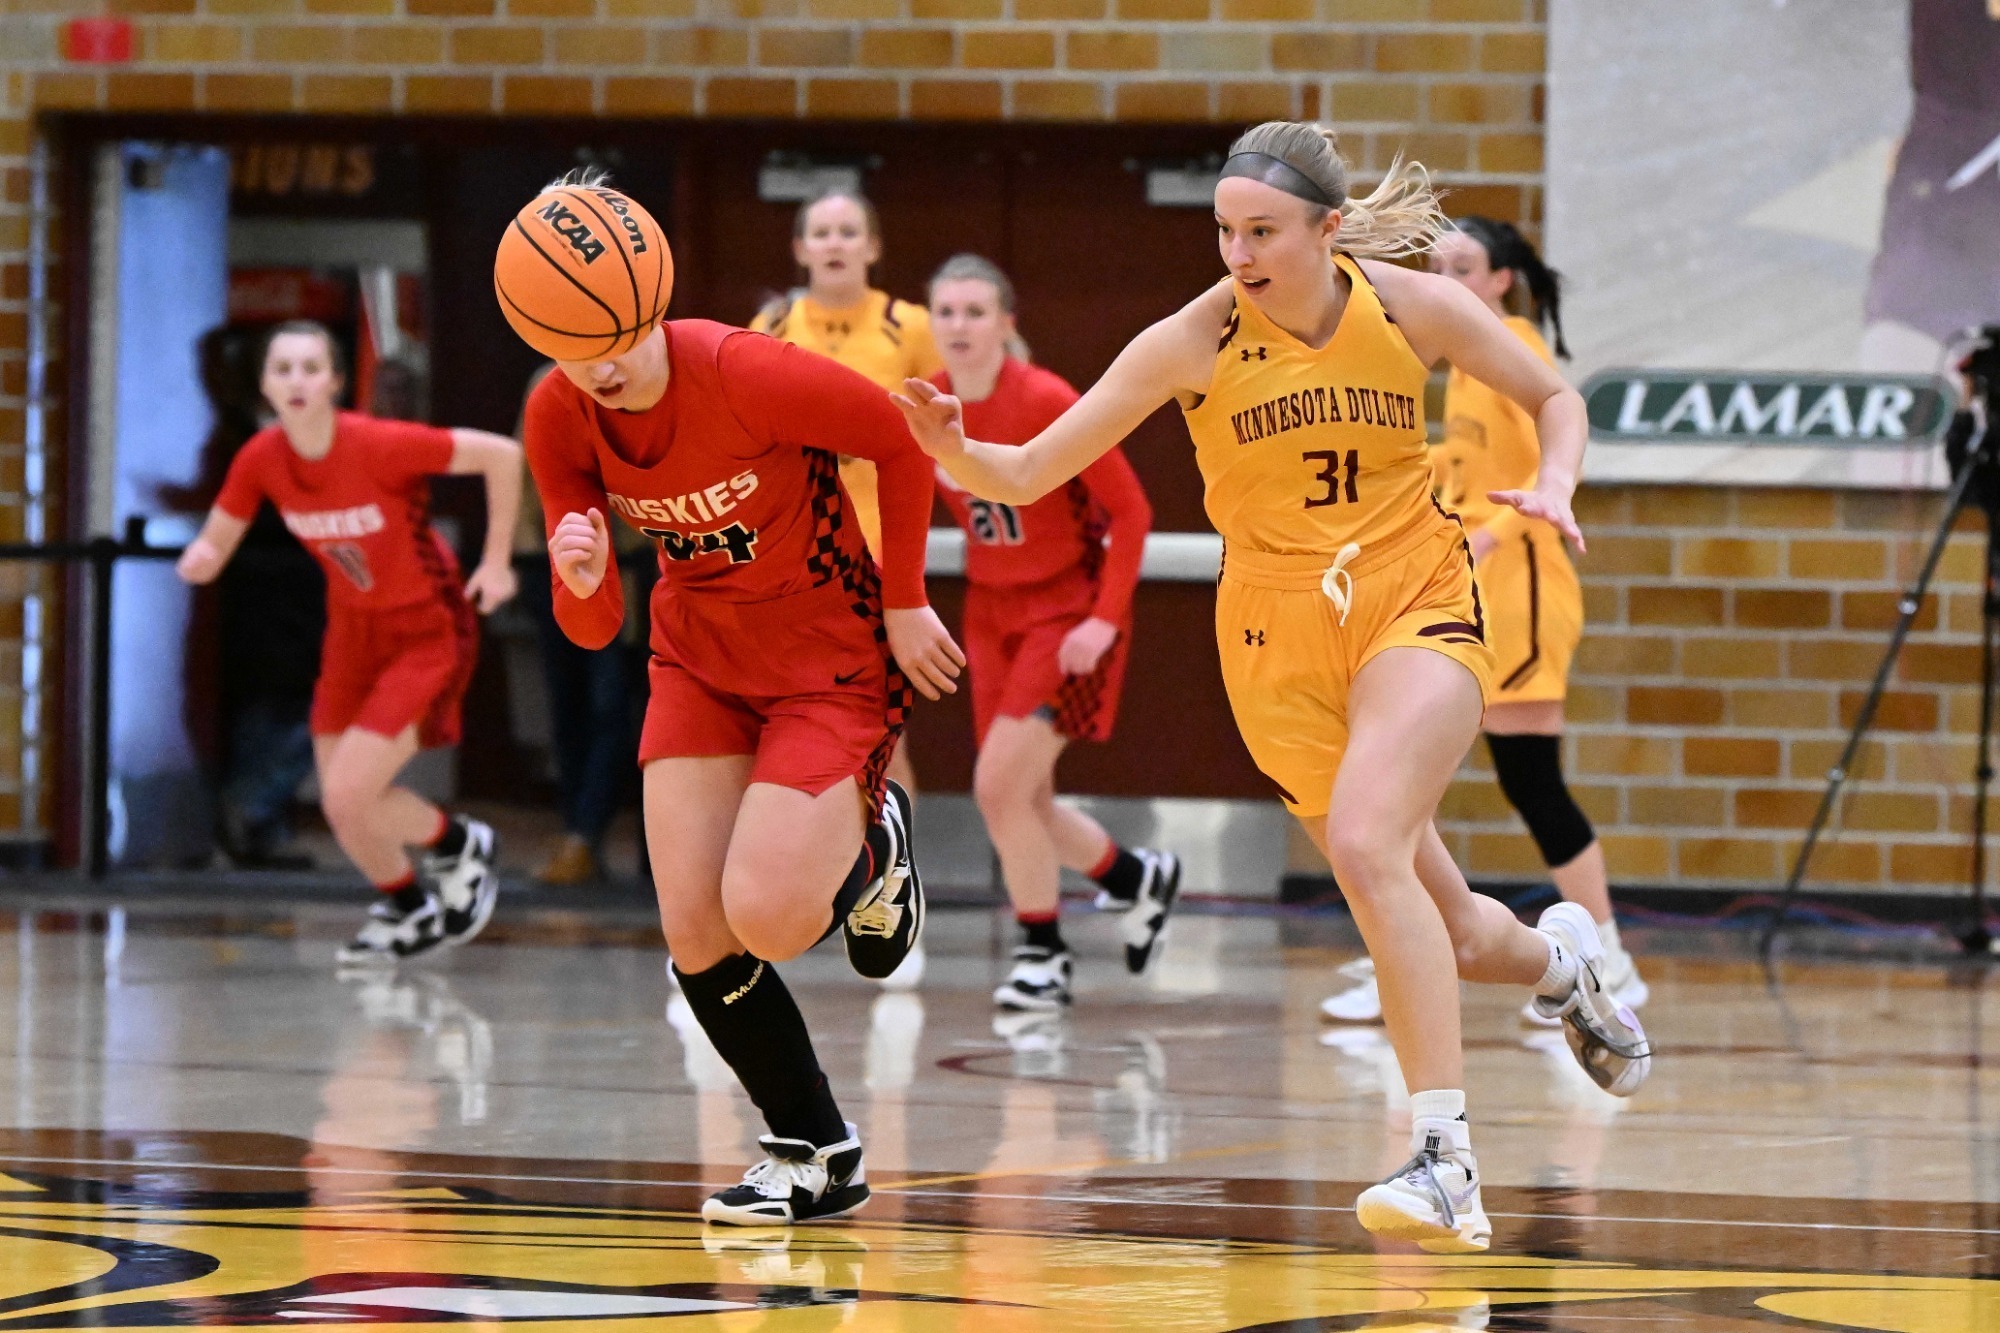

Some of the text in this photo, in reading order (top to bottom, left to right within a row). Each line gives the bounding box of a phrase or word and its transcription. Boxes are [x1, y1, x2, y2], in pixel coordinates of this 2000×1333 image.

[535, 199, 607, 266] NCAA
[1230, 386, 1416, 446] MINNESOTA DULUTH
[1614, 379, 1915, 440] LAMAR
[1302, 449, 1359, 509] 31
